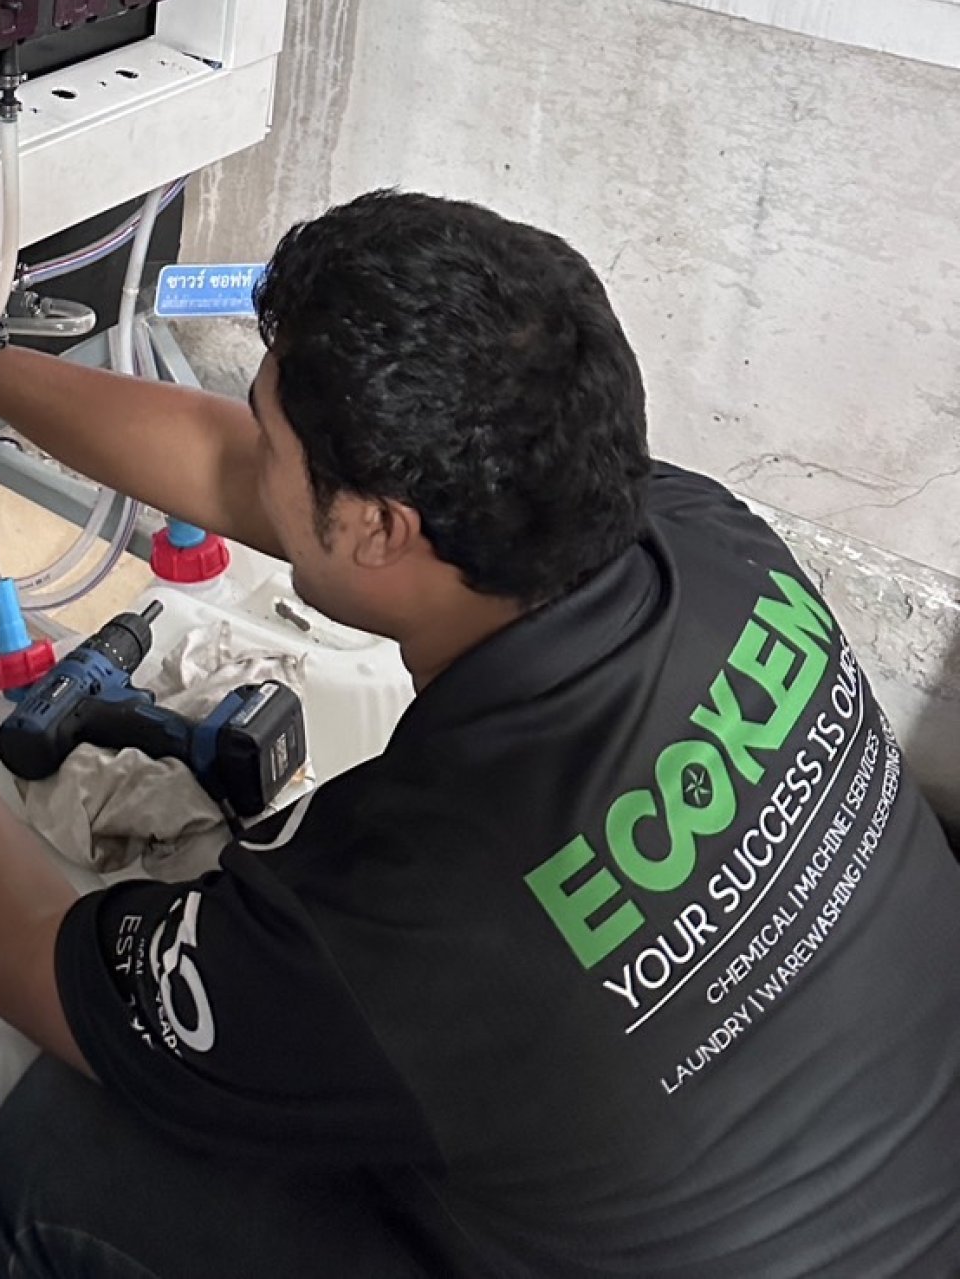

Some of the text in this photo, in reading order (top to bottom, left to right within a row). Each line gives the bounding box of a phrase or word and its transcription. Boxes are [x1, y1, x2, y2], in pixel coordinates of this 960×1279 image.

[523, 569, 833, 970] ECOKEM
[603, 903, 719, 1010] YOUR
[708, 750, 823, 914] SUCCESS
[807, 712, 845, 762] IS
[660, 1004, 753, 1095] LAUNDRY
[756, 862, 862, 1002] WAREWASHING
[858, 744, 901, 863] HOUSEKEEPING
[706, 906, 798, 1004] CHEMICAL
[793, 811, 853, 901] MACHINE
[846, 728, 880, 811] SERVICES
